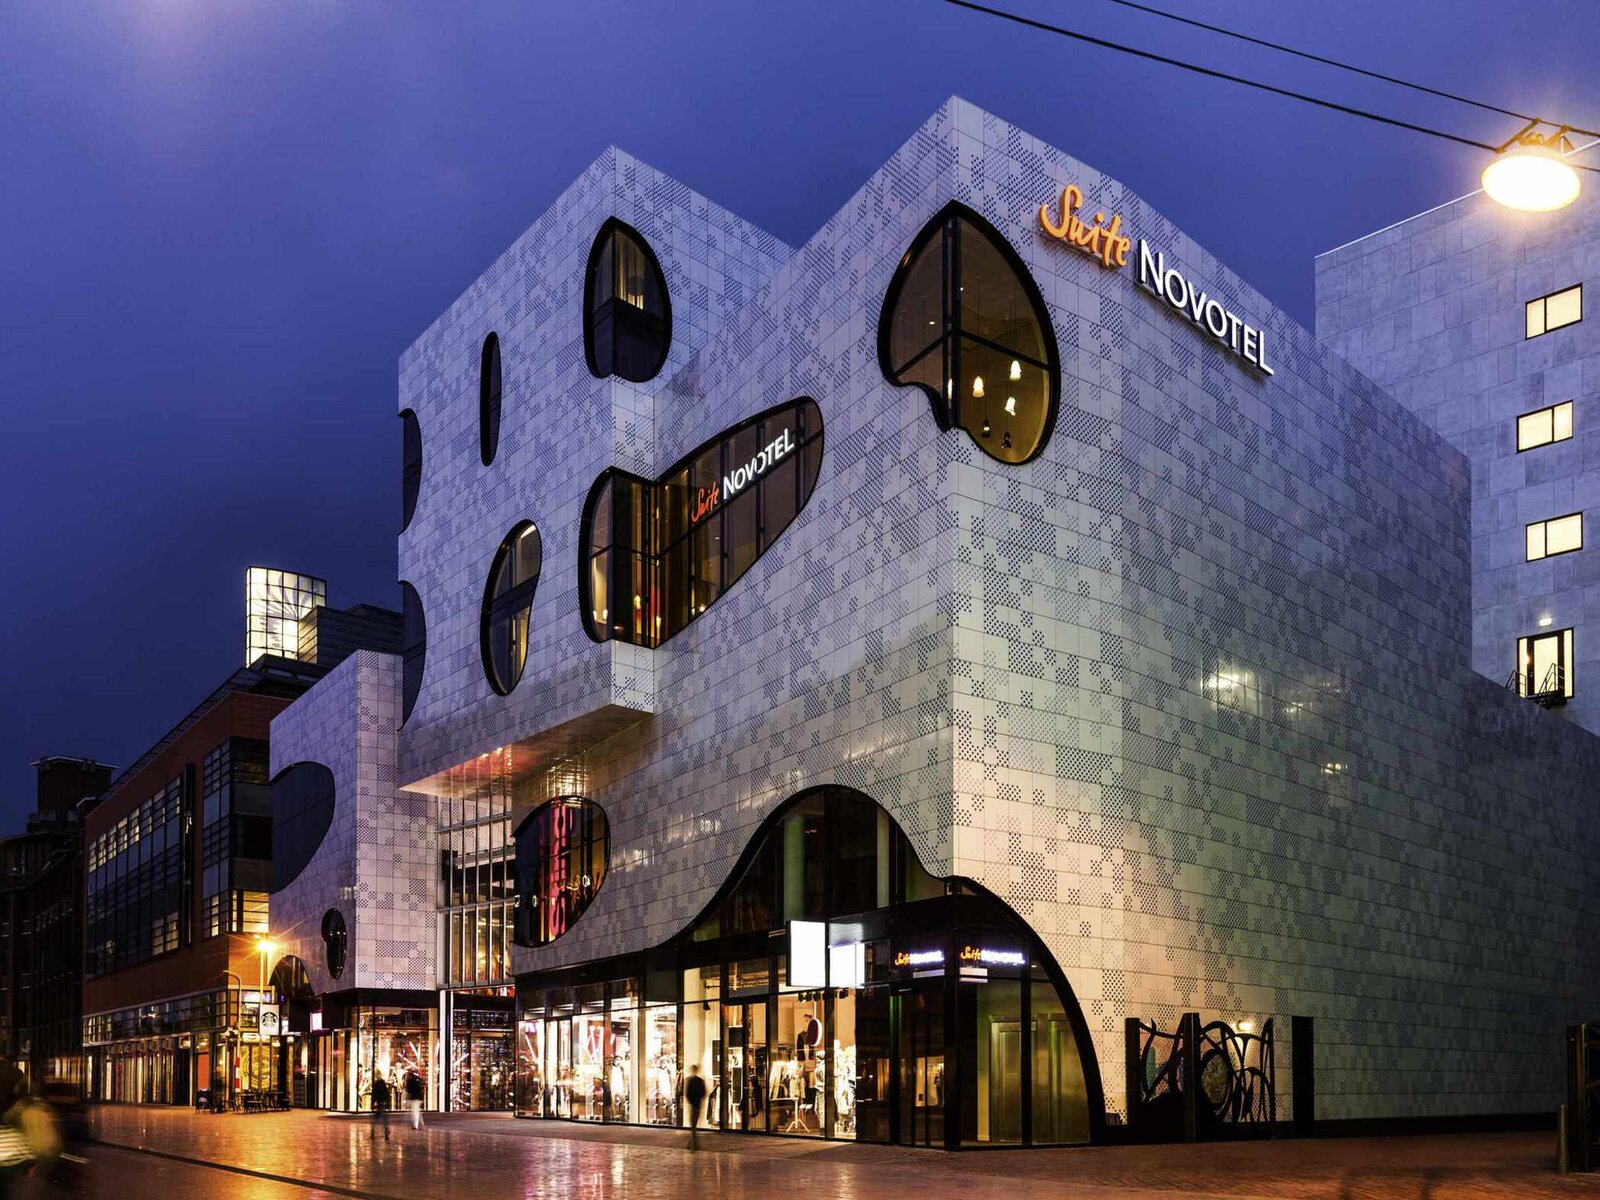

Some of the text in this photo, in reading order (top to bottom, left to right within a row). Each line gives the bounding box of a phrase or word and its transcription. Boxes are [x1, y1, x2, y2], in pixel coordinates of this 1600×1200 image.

[1039, 184, 1274, 375] Suite NOVOTEL
[691, 428, 794, 522] Suite NOVOTEL
